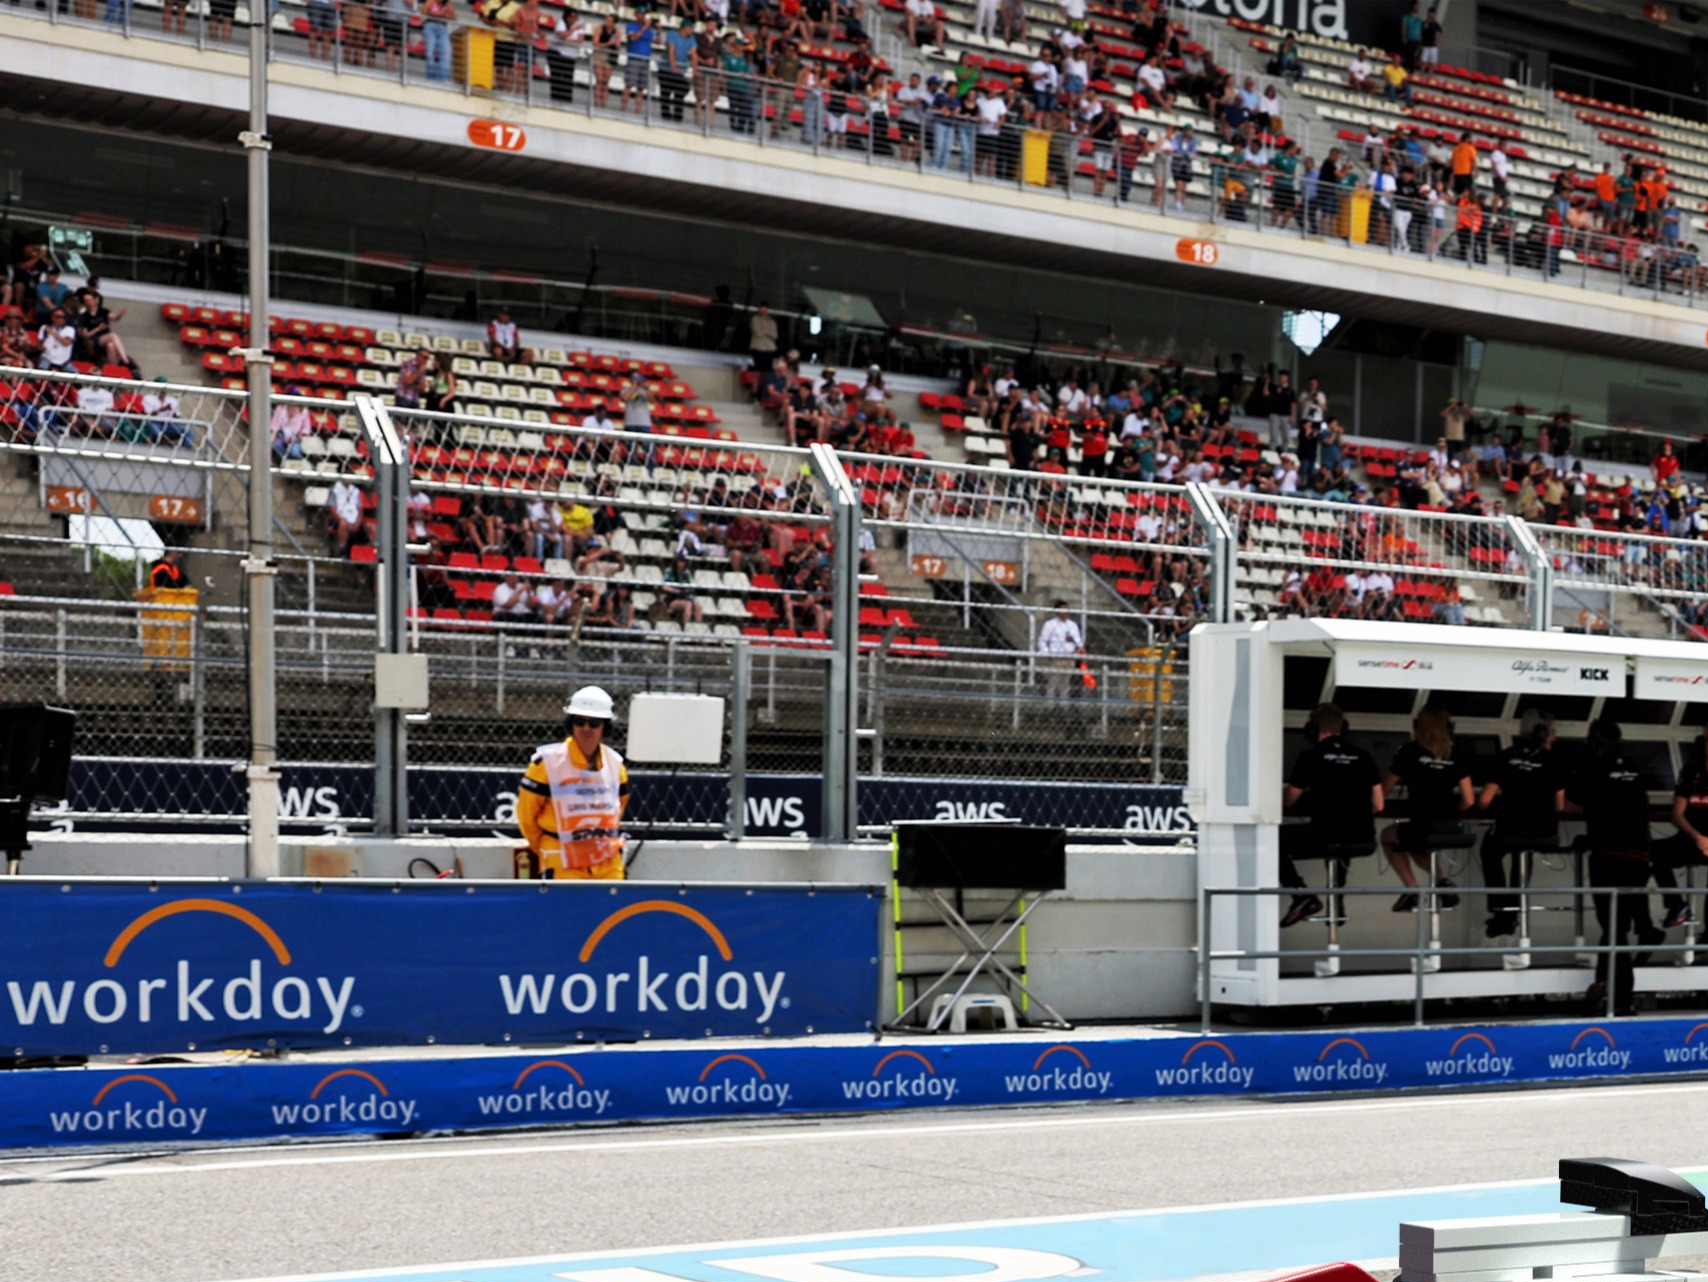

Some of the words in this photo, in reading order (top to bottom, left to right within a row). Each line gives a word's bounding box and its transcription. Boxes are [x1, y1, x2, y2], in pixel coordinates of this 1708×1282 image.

[491, 125, 520, 148] 17
[1191, 243, 1215, 263] 18
[158, 499, 183, 516] 17
[1580, 667, 1609, 681] KICK
[276, 786, 341, 817] ws
[936, 800, 1006, 822] aws
[1125, 805, 1197, 832] aws
[8, 959, 357, 1034] workday
[500, 955, 785, 1024] workday
[1293, 1057, 1386, 1083] workday
[1427, 1053, 1513, 1078] workday
[1549, 1047, 1631, 1069] workday
[843, 1072, 956, 1101] workday
[1006, 1066, 1111, 1093] workday
[1156, 1062, 1254, 1087] workday
[479, 1084, 610, 1114] workday
[667, 1078, 789, 1107] workday
[51, 1101, 208, 1135] workday
[272, 1093, 415, 1124] workday
